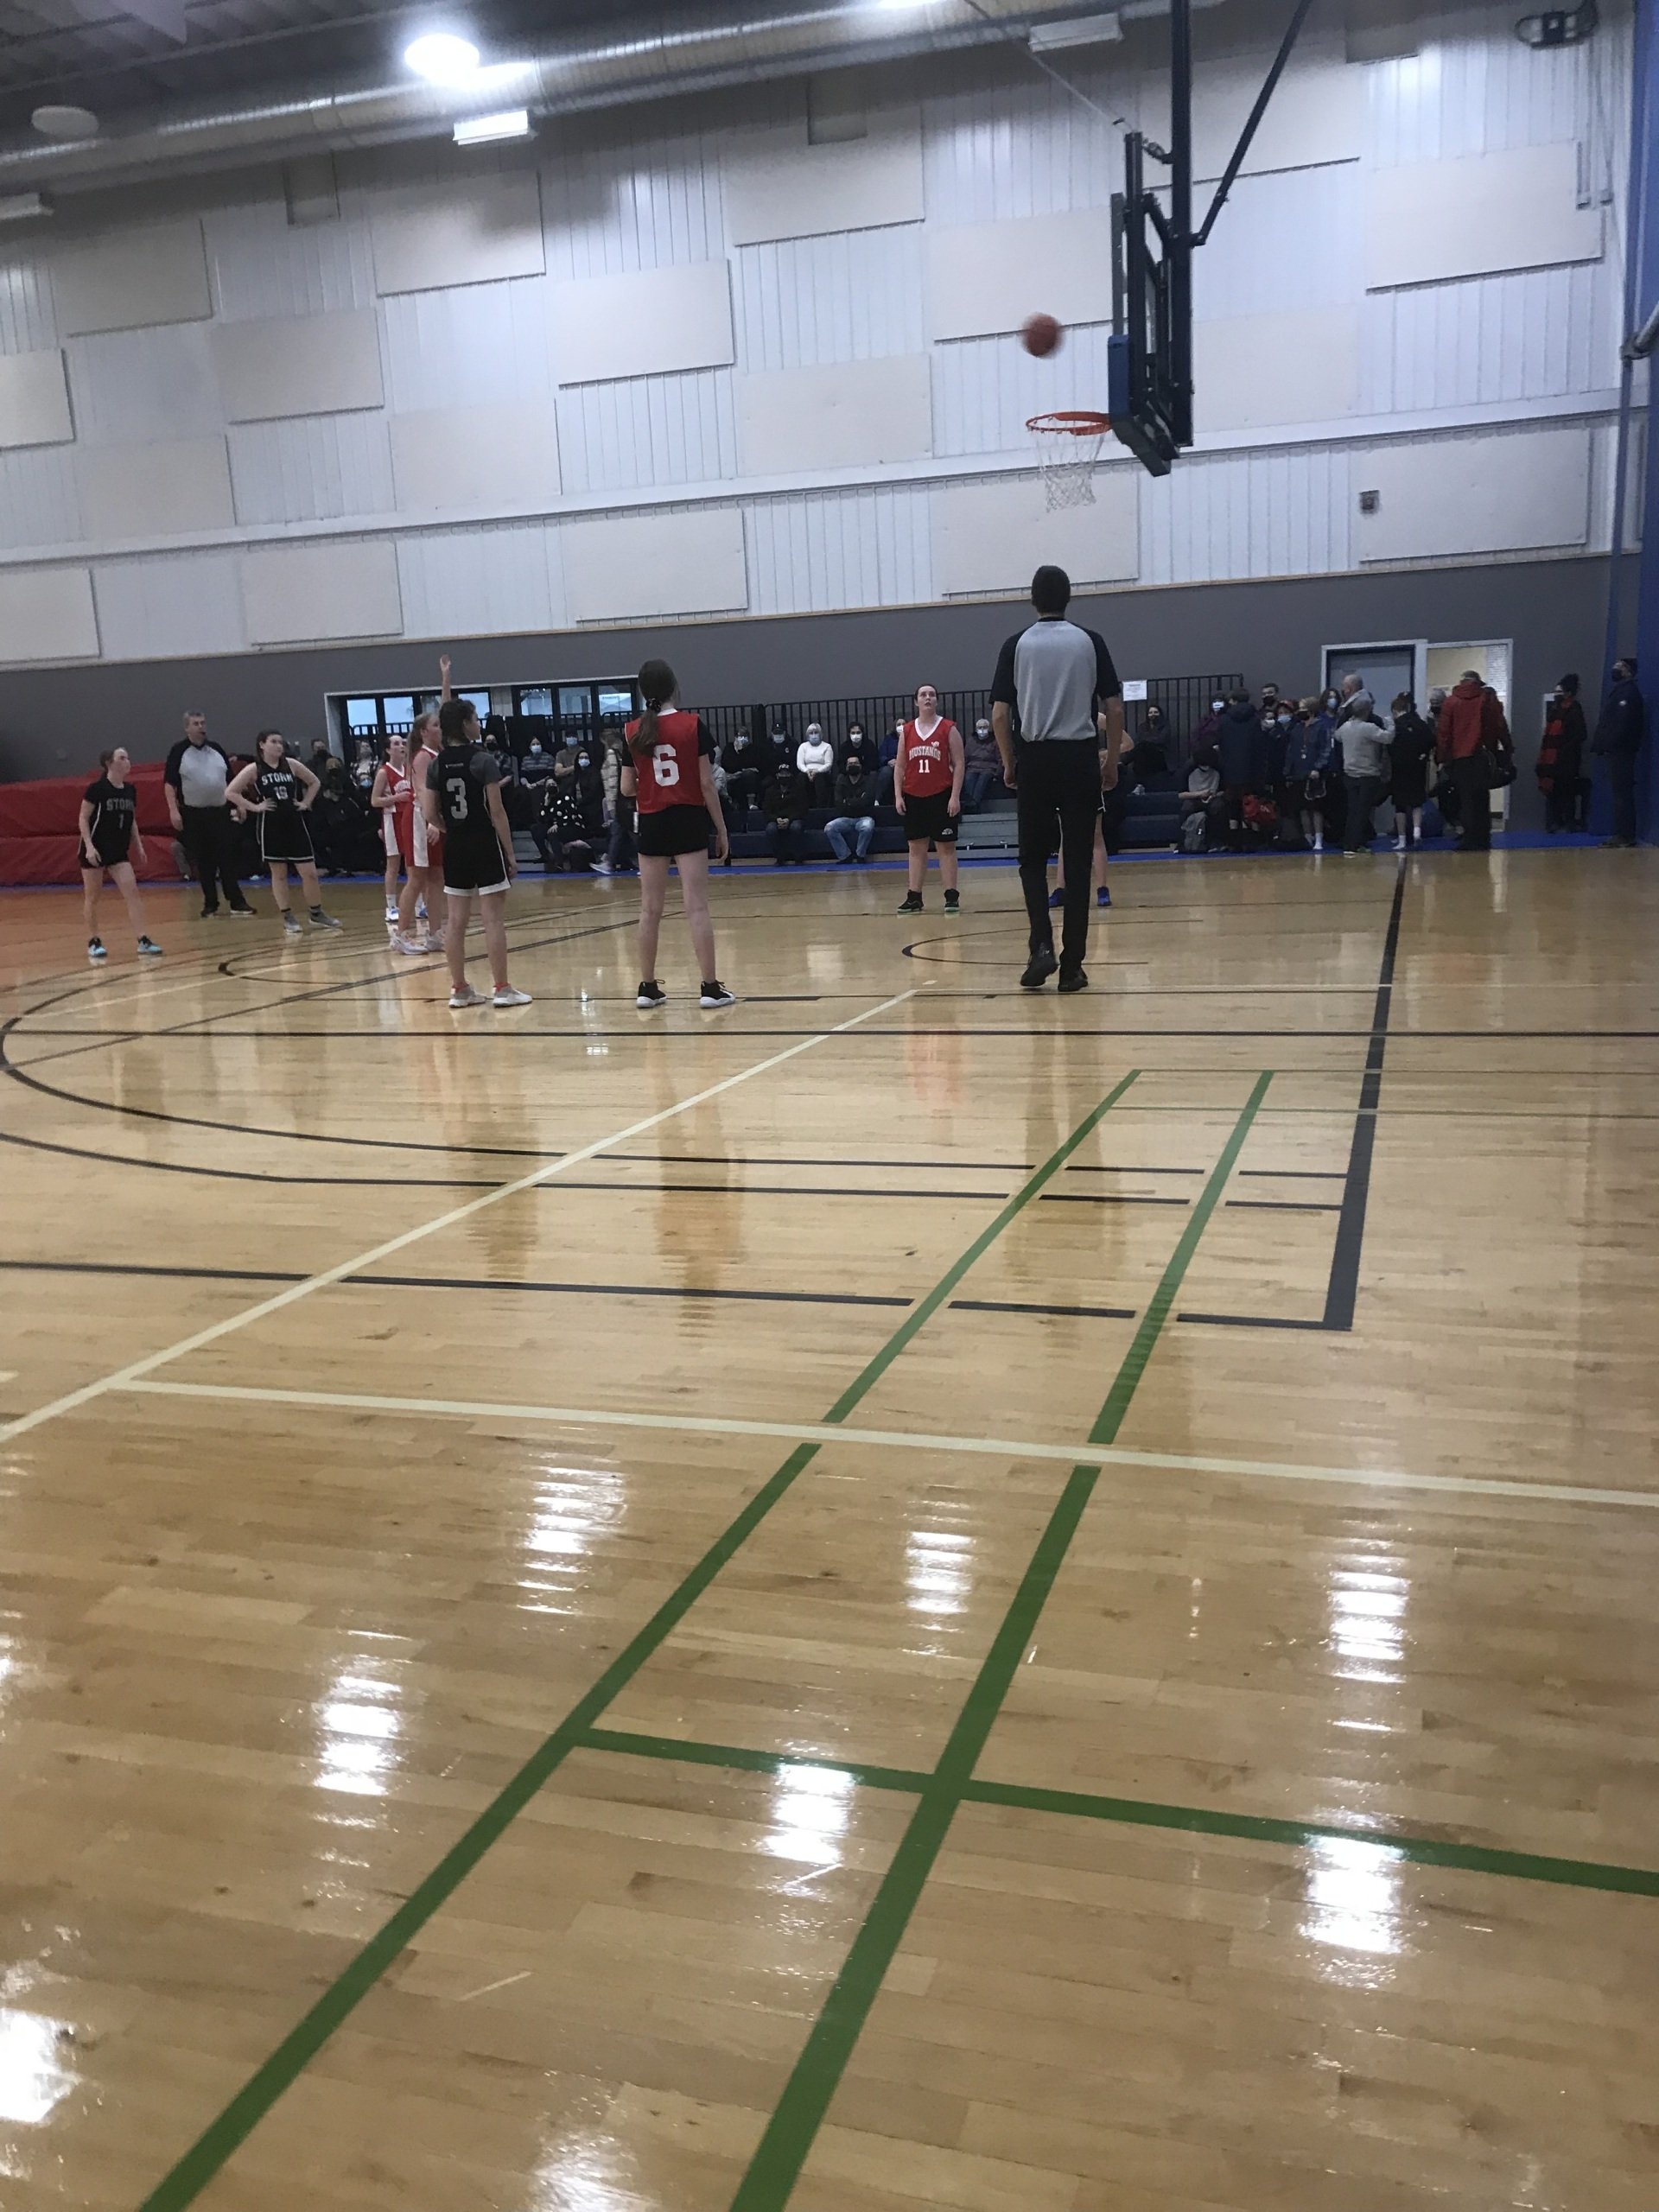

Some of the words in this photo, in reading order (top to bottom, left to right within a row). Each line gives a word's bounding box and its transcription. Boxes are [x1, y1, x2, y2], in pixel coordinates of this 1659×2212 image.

[909, 746, 942, 761] MUSTANGS
[652, 744, 680, 787] 6
[918, 759, 931, 773] 11
[261, 772, 294, 785] STORM
[446, 778, 468, 820] 3
